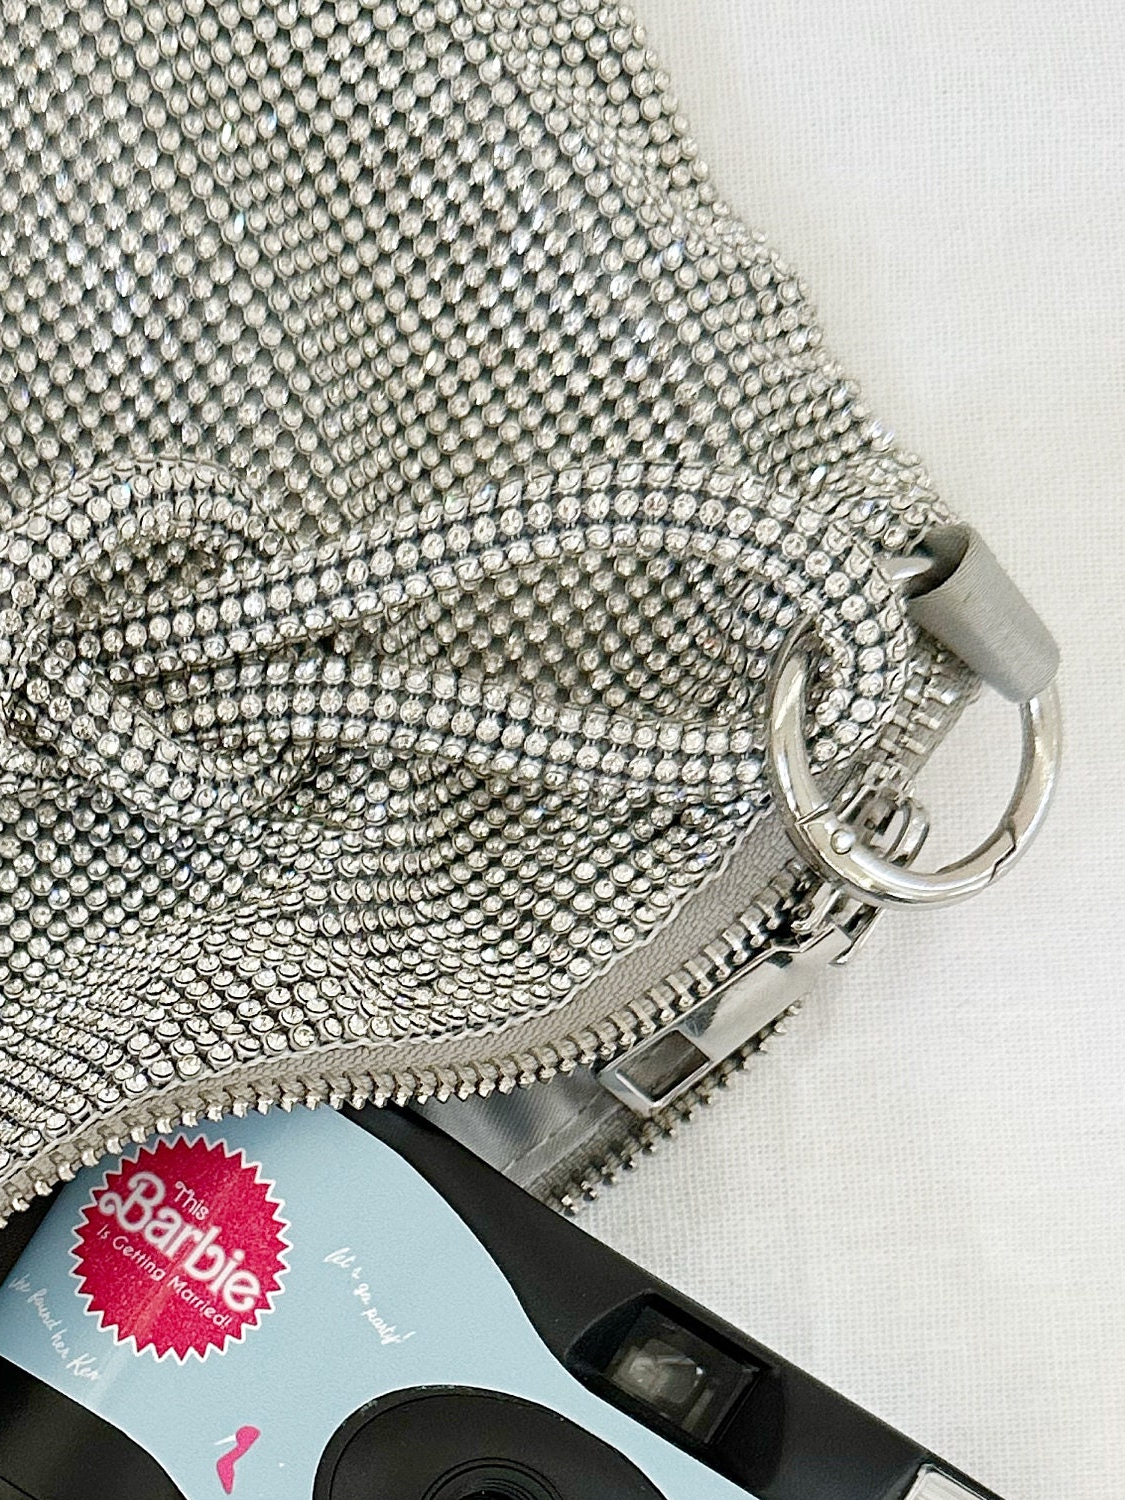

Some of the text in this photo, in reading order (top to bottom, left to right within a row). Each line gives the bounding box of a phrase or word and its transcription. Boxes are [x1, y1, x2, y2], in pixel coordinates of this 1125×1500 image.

[98, 1171, 261, 1312] Barbie
[175, 1180, 209, 1221] This
[96, 1223, 233, 1330] Is Getting Married!
[27, 1287, 62, 1331] found
[51, 1328, 71, 1359] her
[65, 1352, 101, 1382] Ken
